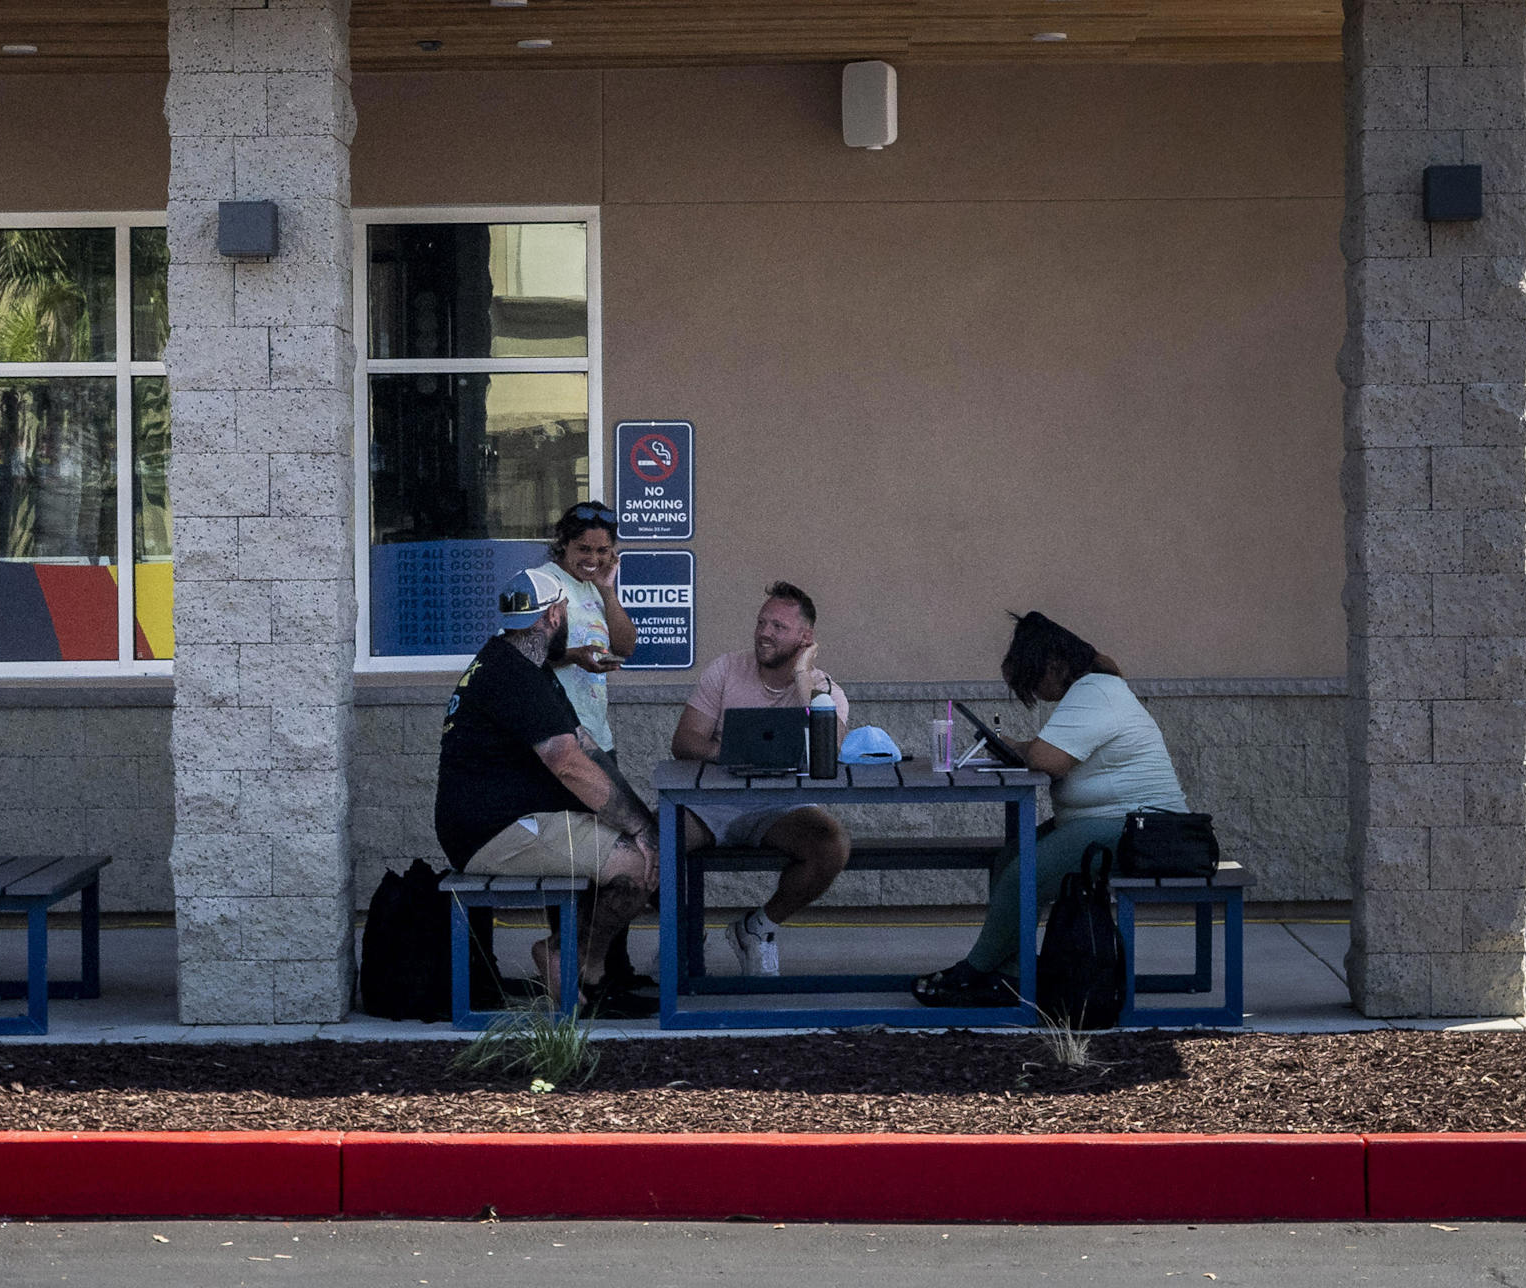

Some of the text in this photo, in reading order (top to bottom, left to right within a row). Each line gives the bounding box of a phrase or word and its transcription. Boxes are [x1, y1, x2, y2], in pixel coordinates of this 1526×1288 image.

[644, 486, 664, 496] NO
[625, 499, 683, 510] SMOKING
[621, 513, 687, 523] OR VAPING
[450, 548, 494, 558] GOOD
[450, 560, 494, 570] GOOD
[451, 574, 494, 584] GOOD
[451, 586, 495, 596] GOOD
[622, 589, 689, 603] NOTICE
[451, 598, 495, 608] GOOD
[451, 610, 495, 620] GOOD
[451, 622, 495, 632] GOOD
[651, 636, 688, 645] CAMERA
